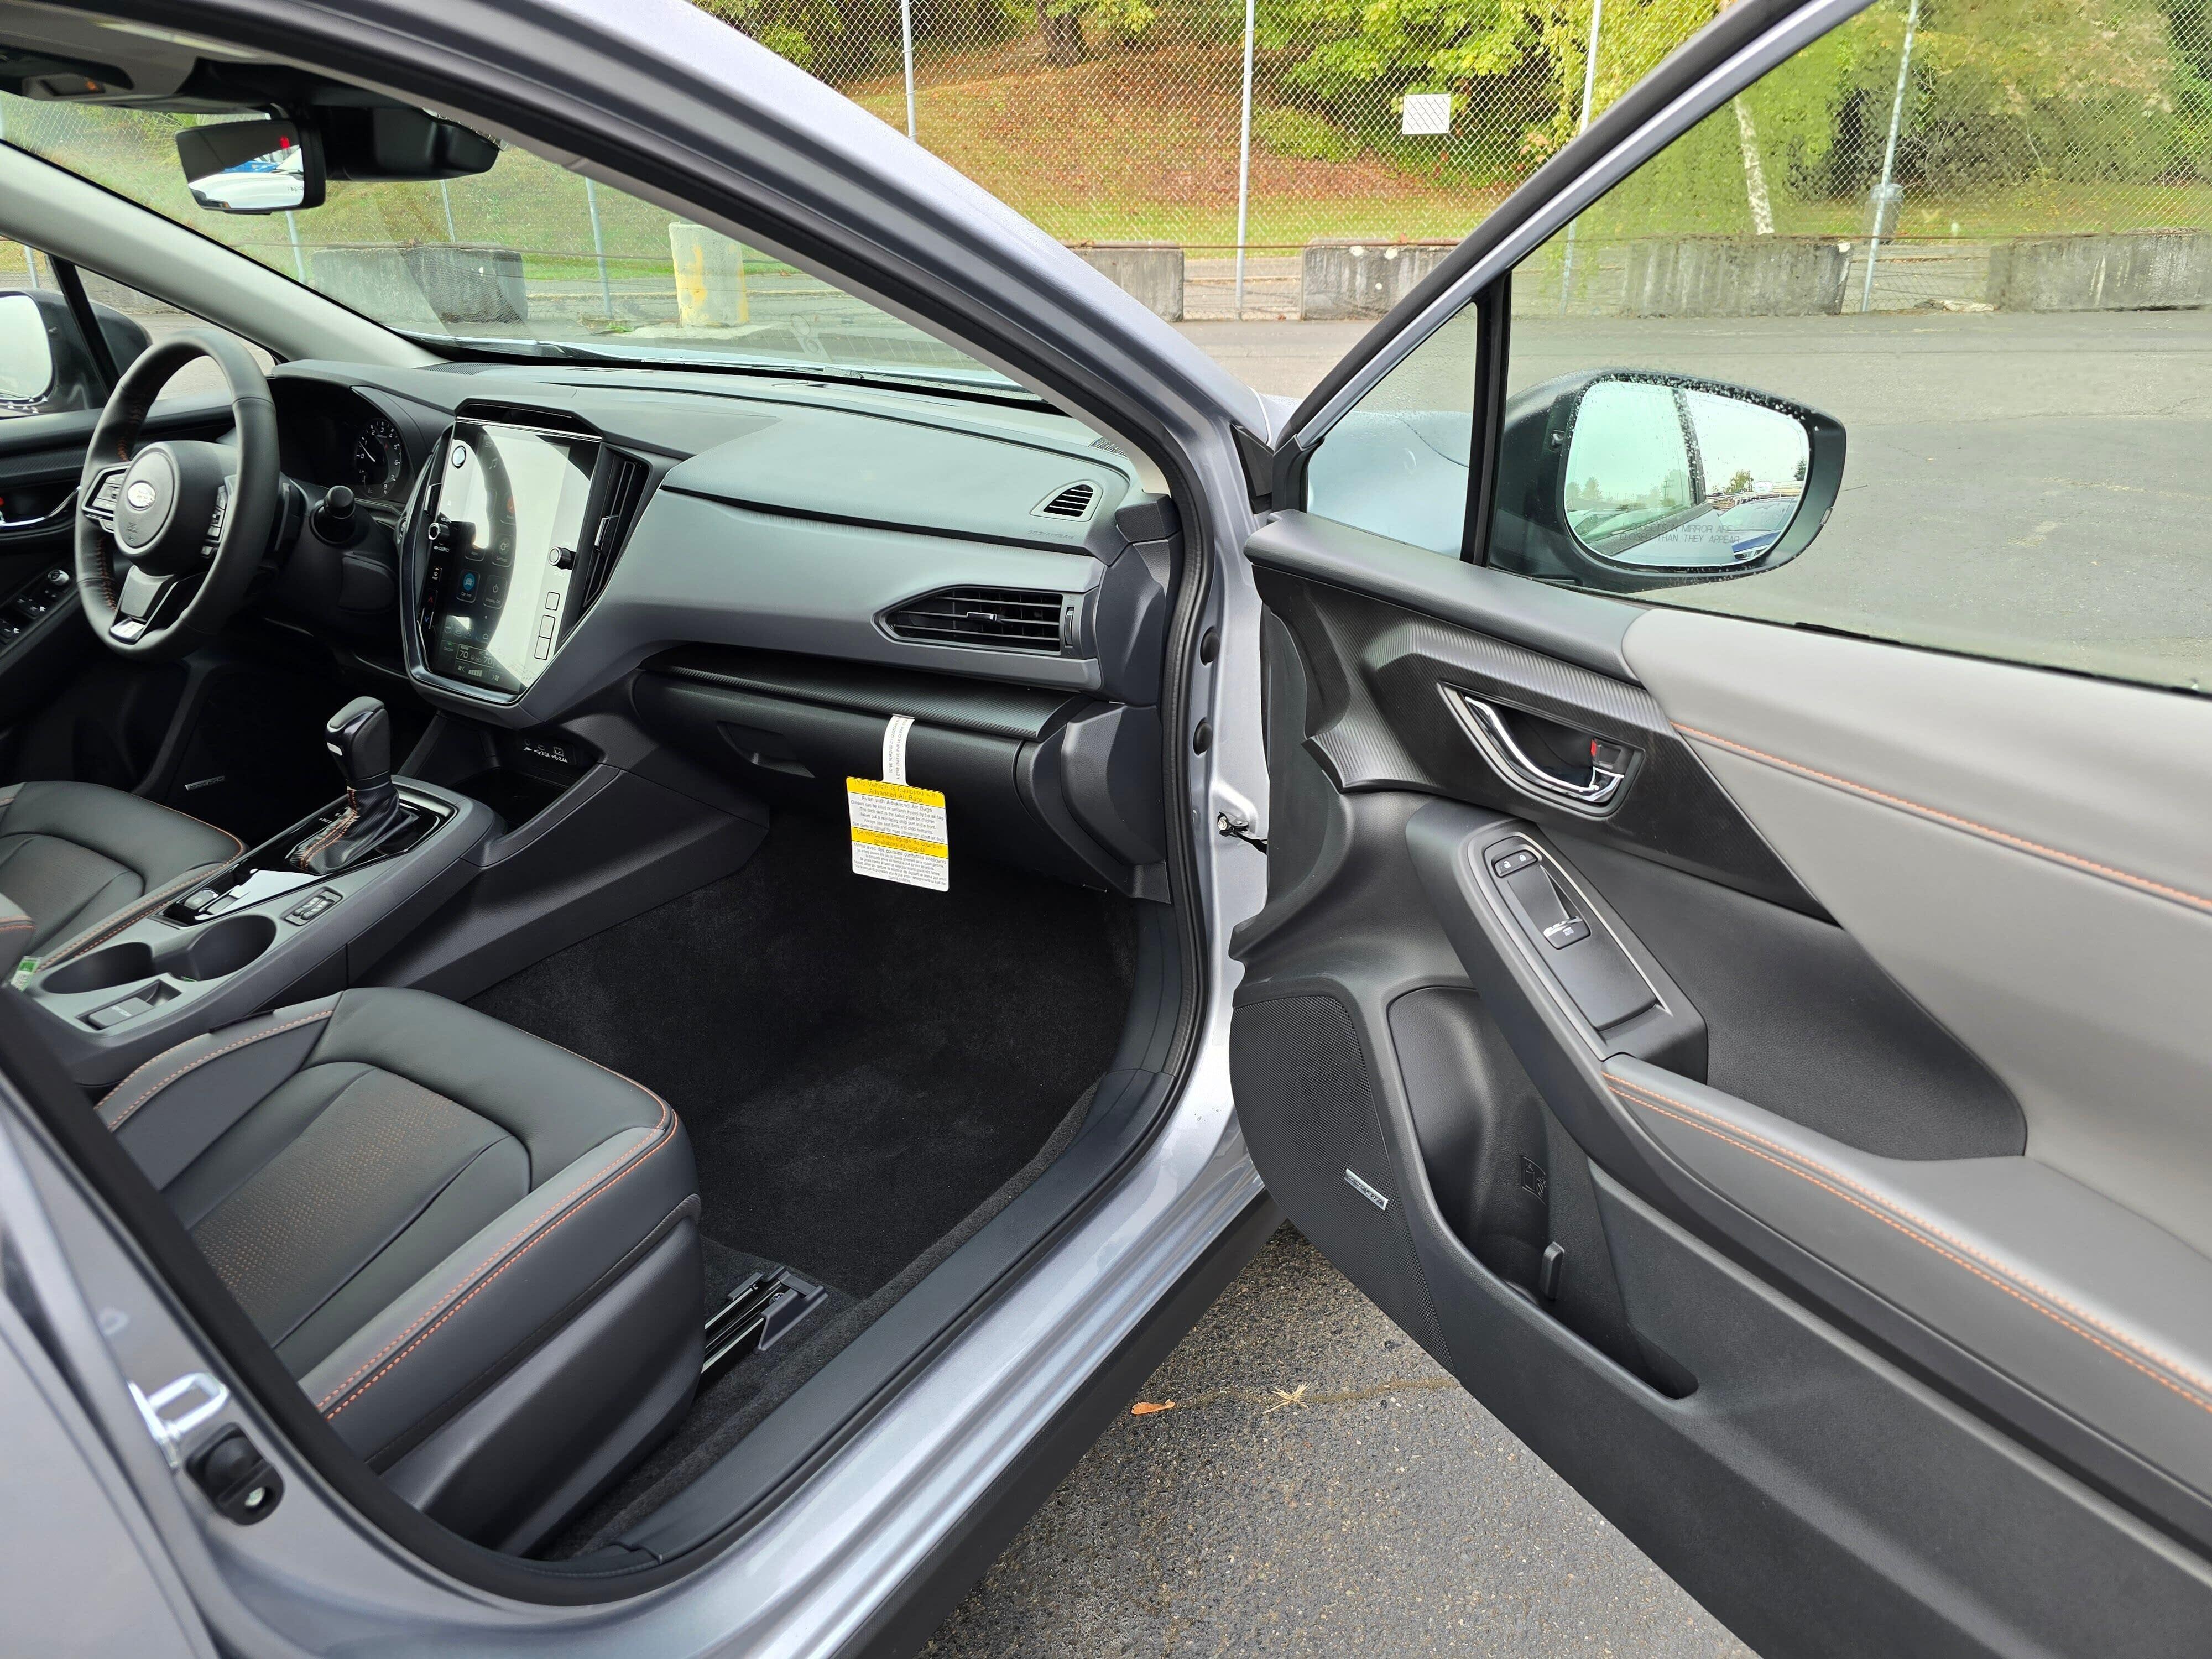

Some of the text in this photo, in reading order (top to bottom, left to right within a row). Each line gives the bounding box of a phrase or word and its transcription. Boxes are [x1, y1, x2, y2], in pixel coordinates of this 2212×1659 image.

[1680, 524, 1713, 533] MIRROR
[1716, 525, 1733, 533] ARE
[1658, 534, 1678, 542] THAN
[1684, 534, 1704, 543] THEY
[1709, 535, 1740, 544] APPEAR
[459, 650, 468, 659] 70
[483, 656, 493, 665] 70
[869, 789, 896, 797] Advanced
[898, 786, 924, 796] Equipped
